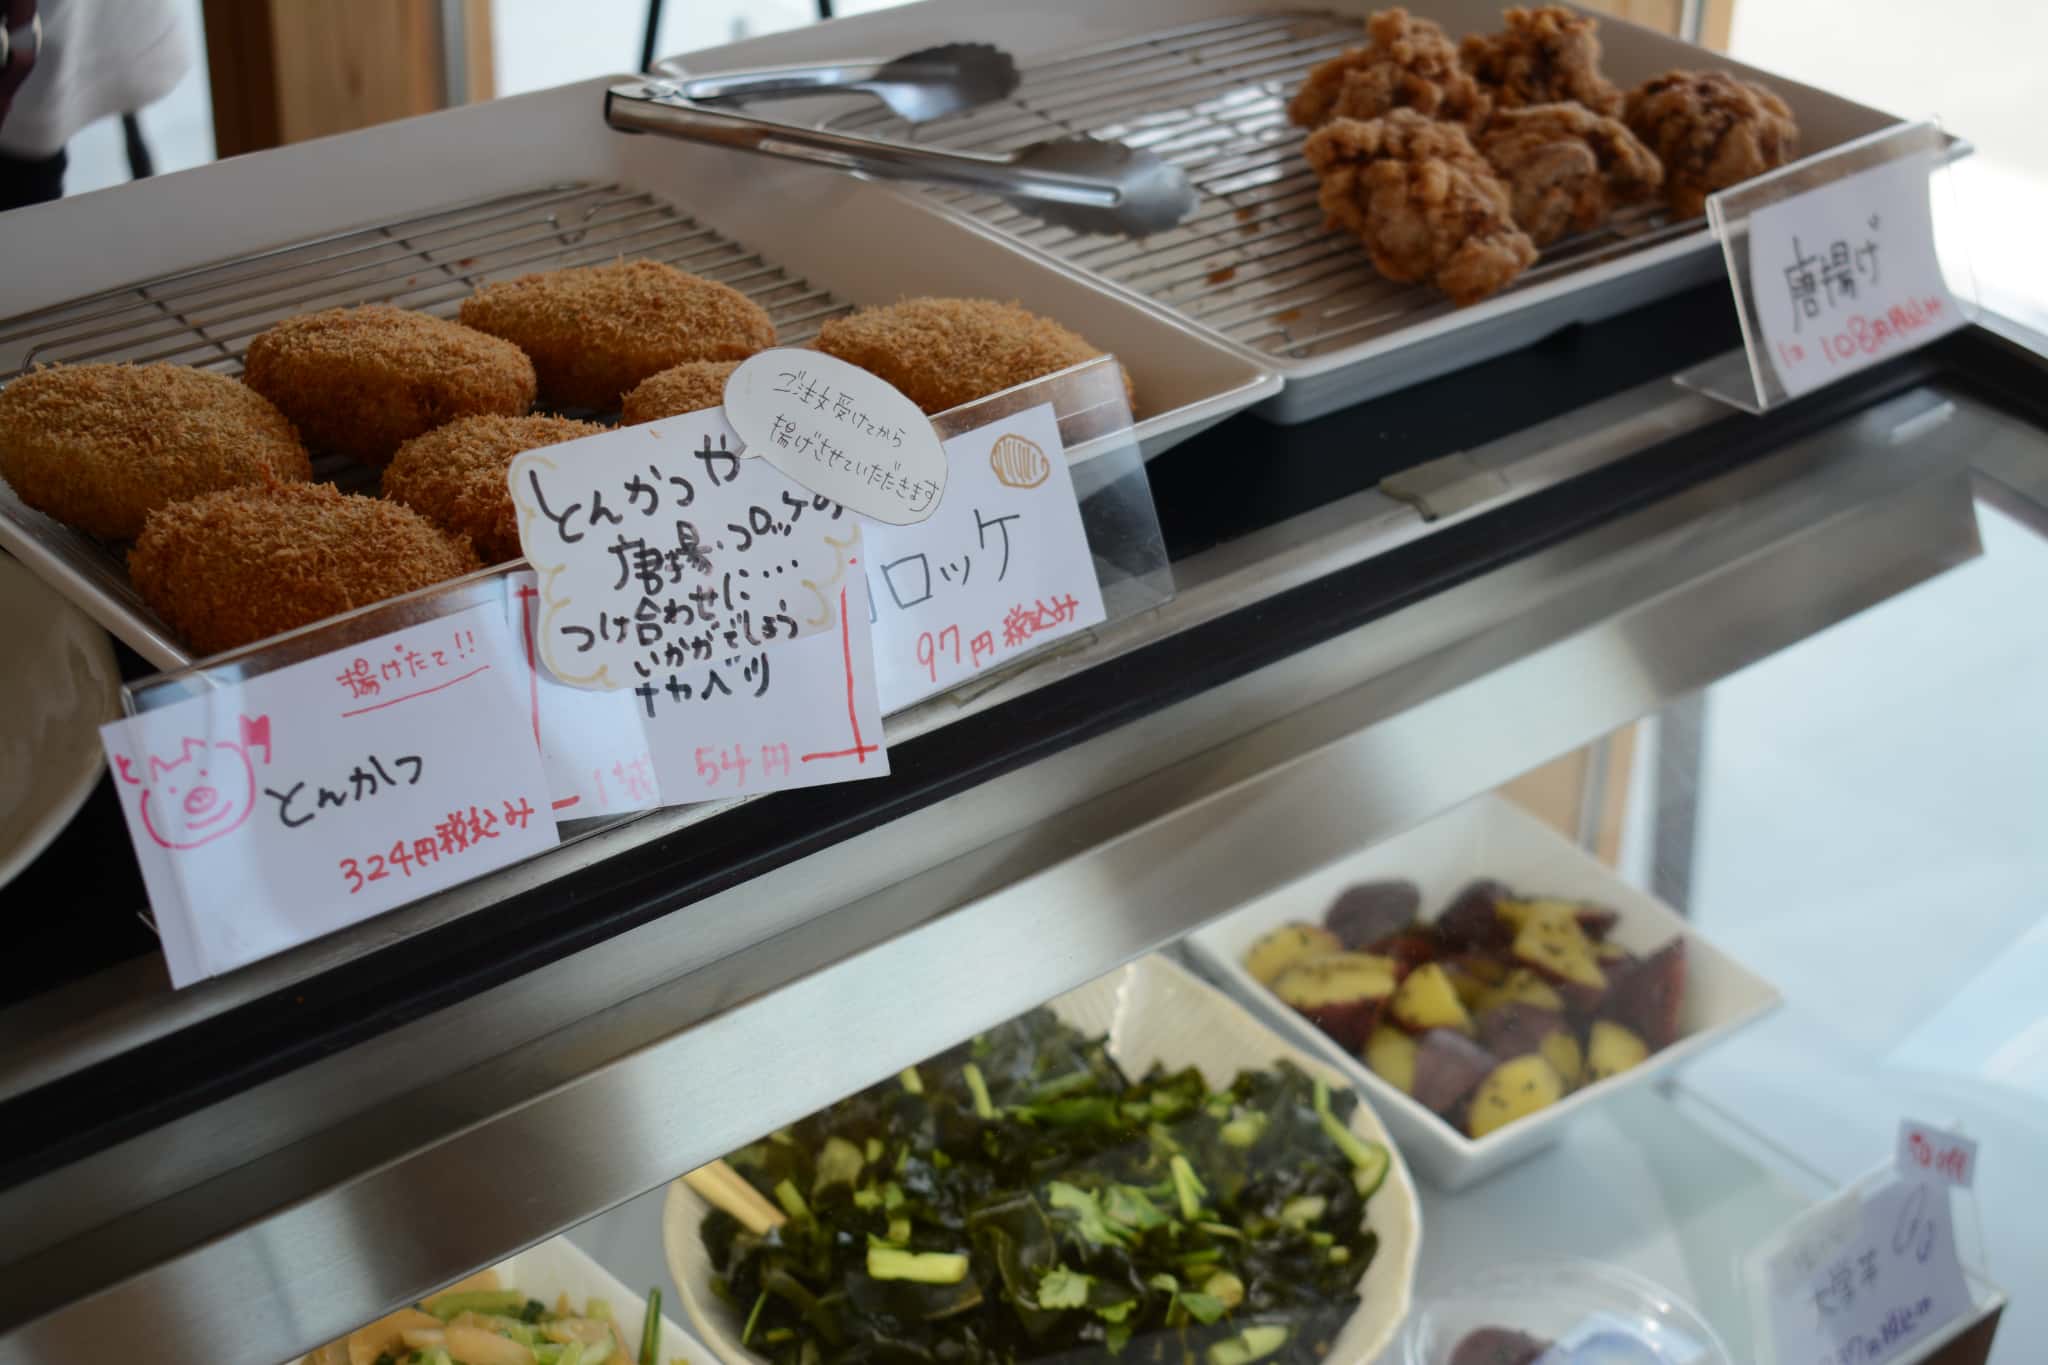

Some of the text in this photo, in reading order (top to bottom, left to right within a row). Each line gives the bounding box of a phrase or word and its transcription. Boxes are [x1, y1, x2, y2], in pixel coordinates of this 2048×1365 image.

[1783, 212, 1882, 334] 唐揚げ
[772, 370, 907, 448] ご注文受けてから
[529, 434, 741, 544] とんかつや
[769, 413, 940, 513] 揚げさせていただきます
[864, 509, 1021, 624] ロッケ
[634, 599, 799, 678] いかがでしょう
[264, 755, 423, 829] とんかつ
[694, 742, 791, 787] 54円
[339, 797, 535, 894] 324円税込み
